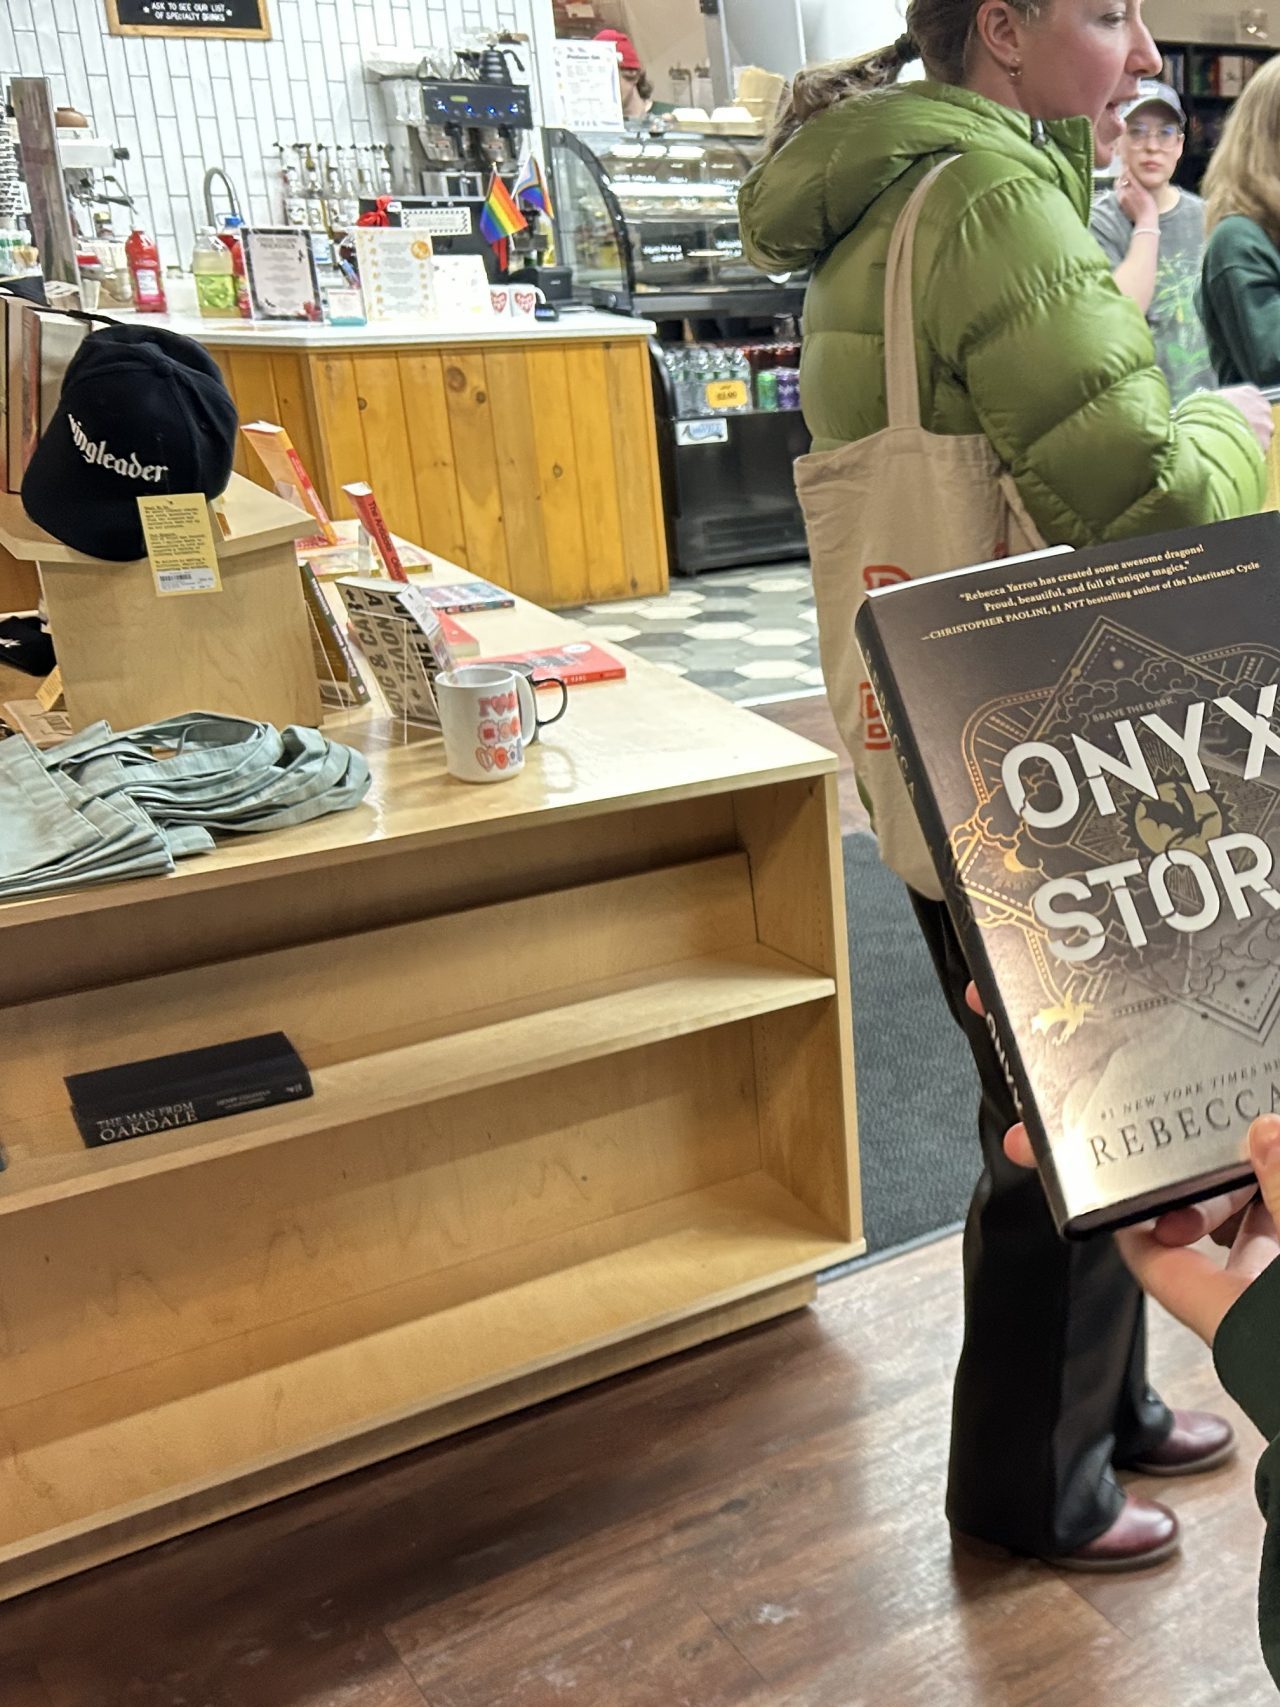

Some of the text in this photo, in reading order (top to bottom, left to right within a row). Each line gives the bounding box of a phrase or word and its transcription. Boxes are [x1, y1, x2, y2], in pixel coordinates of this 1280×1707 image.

[151, 2, 224, 12] ASK TO SEE OUR LIST
[154, 11, 225, 22] OF SPECIALTY DRINKS
[1006, 580, 1038, 593] Yarros
[1039, 577, 1057, 587] has
[1058, 567, 1092, 582] created
[1094, 562, 1119, 573] some
[1121, 555, 1163, 569] awesome
[1164, 544, 1205, 561] dragons!
[364, 591, 383, 607] A
[983, 601, 1017, 613] Proud,
[1018, 588, 1065, 604] beautiful,
[1067, 583, 1085, 595] and
[1086, 578, 1104, 590] full
[1105, 576, 1116, 586] of
[1118, 571, 1150, 585] unique
[1005, 607, 1051, 623] PAOLINI,
[1051, 604, 1061, 613] #1
[1064, 600, 1085, 611] NYT
[1087, 590, 1132, 606] bestselling
[1133, 584, 1160, 596] author
[1162, 580, 1171, 590] of
[1173, 578, 1186, 588] the
[1187, 568, 1235, 584] Inheritance
[1236, 561, 1260, 574] Cycle
[1092, 709, 1125, 722] BRAVE
[1126, 704, 1146, 715] THE
[1101, 1107, 1114, 1120] #1
[1123, 1095, 1157, 1115] NEW
[1163, 1081, 1203, 1103] YORK
[1211, 1064, 1257, 1089] TIMES
[96, 1101, 194, 1129] THE MAN FROM
[100, 1110, 198, 1141] OAKDALE
